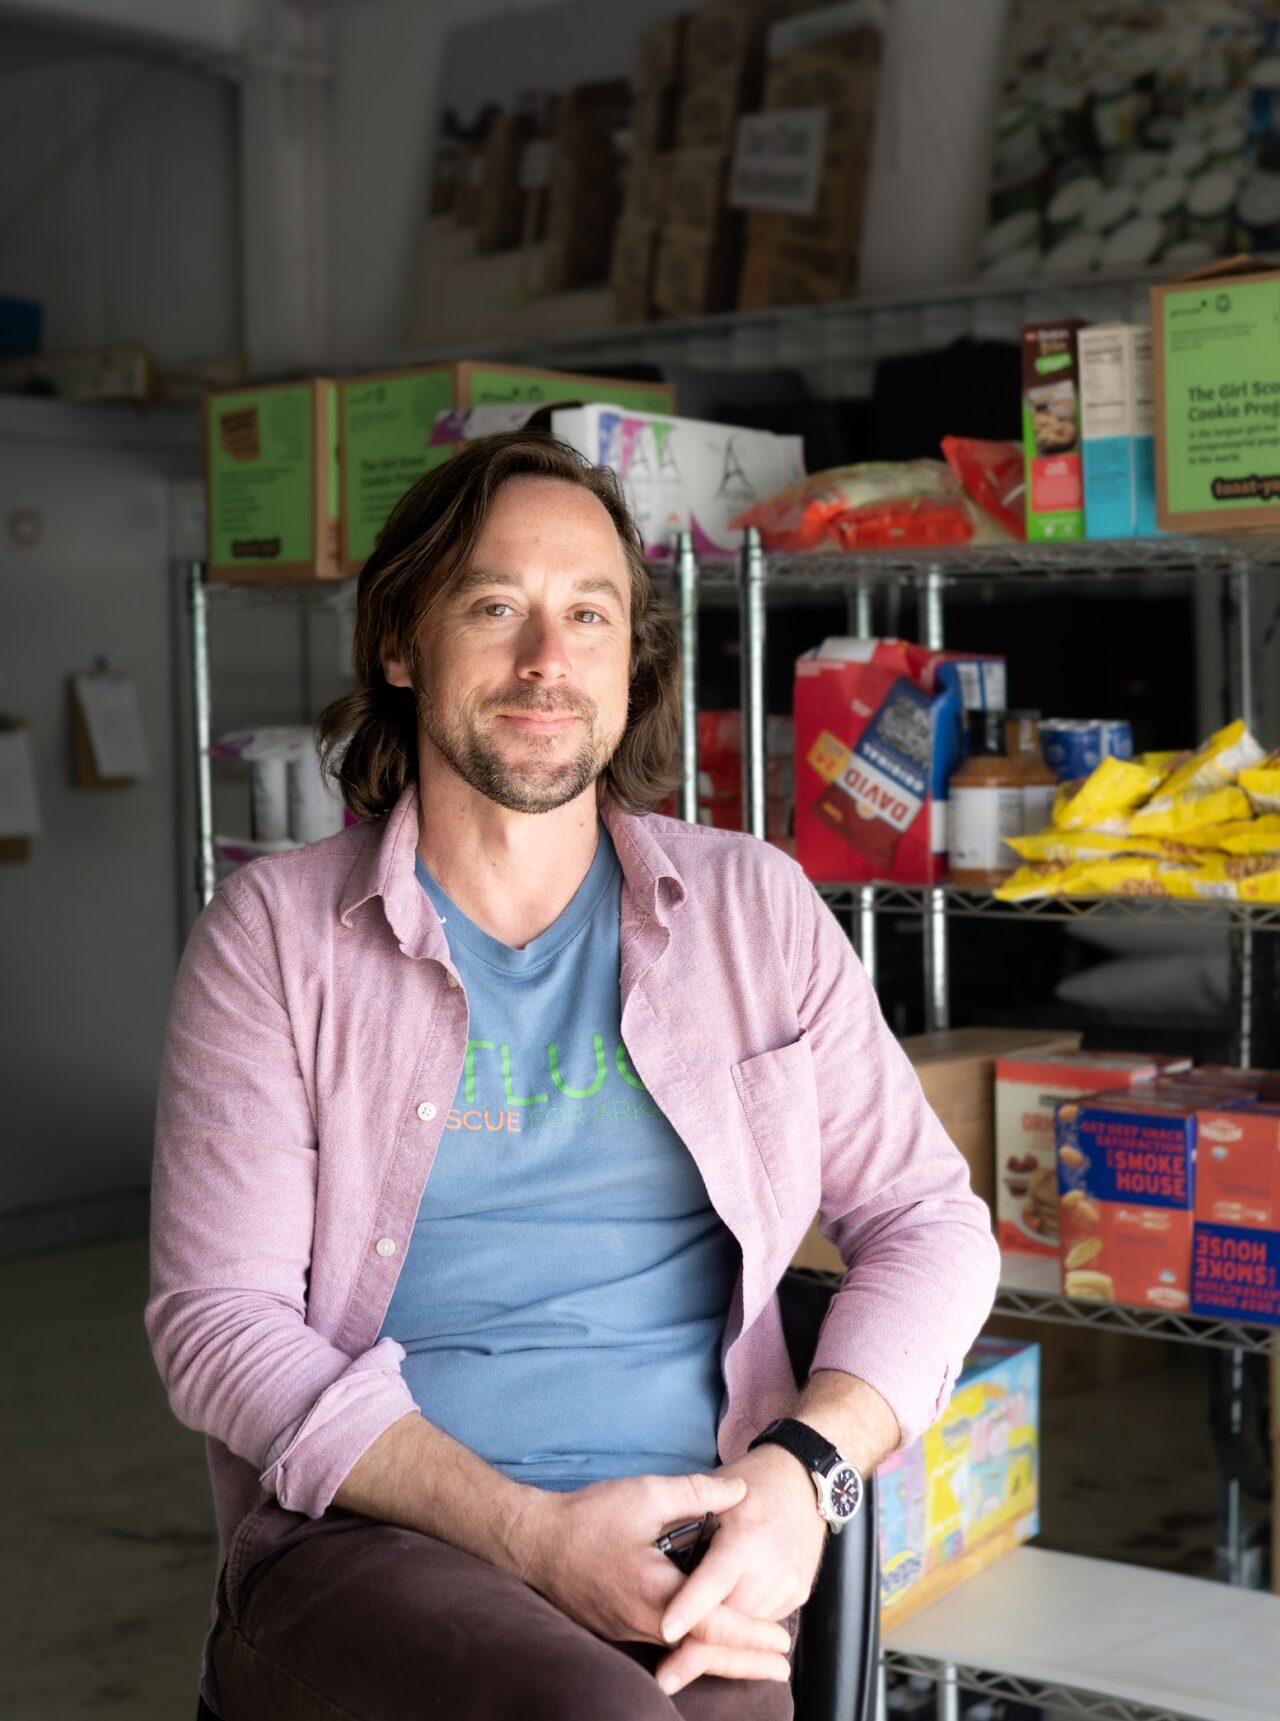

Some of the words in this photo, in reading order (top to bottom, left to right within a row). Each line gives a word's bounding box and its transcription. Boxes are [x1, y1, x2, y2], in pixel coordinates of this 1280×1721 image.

[1187, 386, 1215, 404] The
[1219, 381, 1248, 399] Girl
[1187, 403, 1240, 423] Cookie
[861, 742, 926, 791] ORIGINAL
[844, 768, 909, 821] DAVID
[445, 1108, 522, 1133] SCUE
[529, 1105, 585, 1129] FOR
[1115, 1149, 1185, 1176] SMOKE
[1116, 1171, 1186, 1199] HOUSE
[1196, 1234, 1267, 1262] HOUSE
[1196, 1257, 1268, 1286] SMOKE
